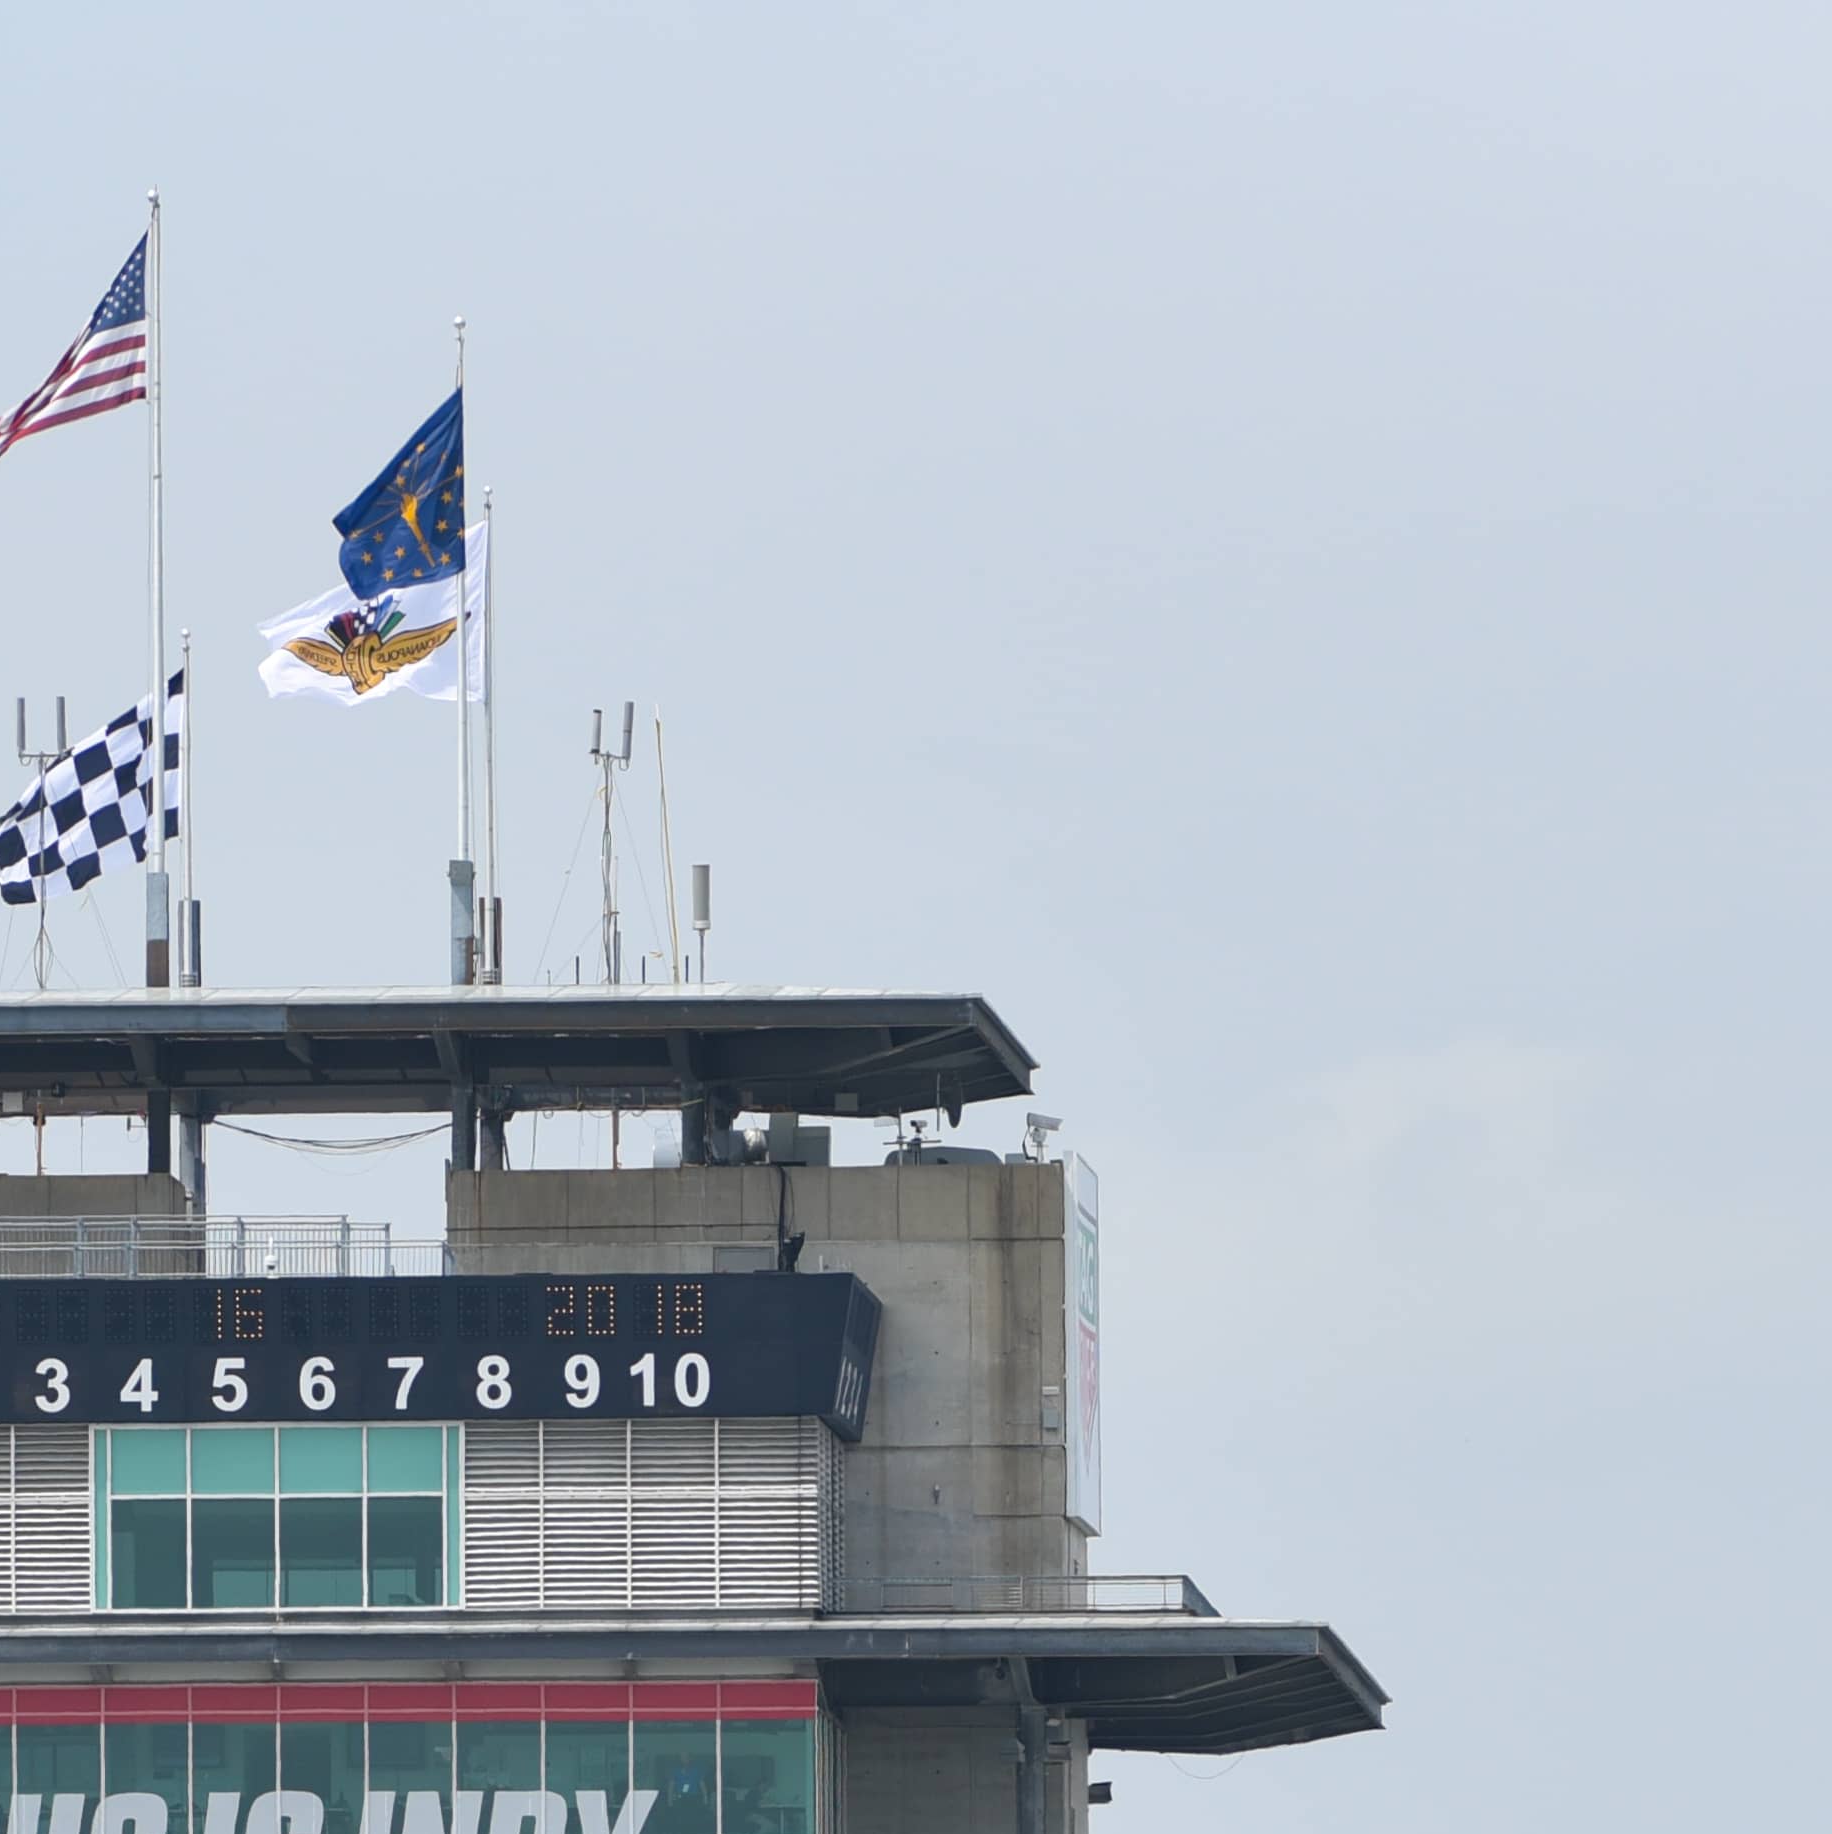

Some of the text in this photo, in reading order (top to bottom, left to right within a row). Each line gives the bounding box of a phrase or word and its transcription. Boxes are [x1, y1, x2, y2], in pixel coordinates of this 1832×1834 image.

[216, 1287, 265, 1340] 16
[34, 1358, 71, 1413] 3
[120, 1358, 159, 1413] 4
[211, 1357, 249, 1412] 5
[299, 1356, 336, 1411] 6
[387, 1356, 424, 1410] 7
[475, 1355, 512, 1410] 8
[564, 1353, 601, 1409] 9
[629, 1352, 710, 1408] 10
